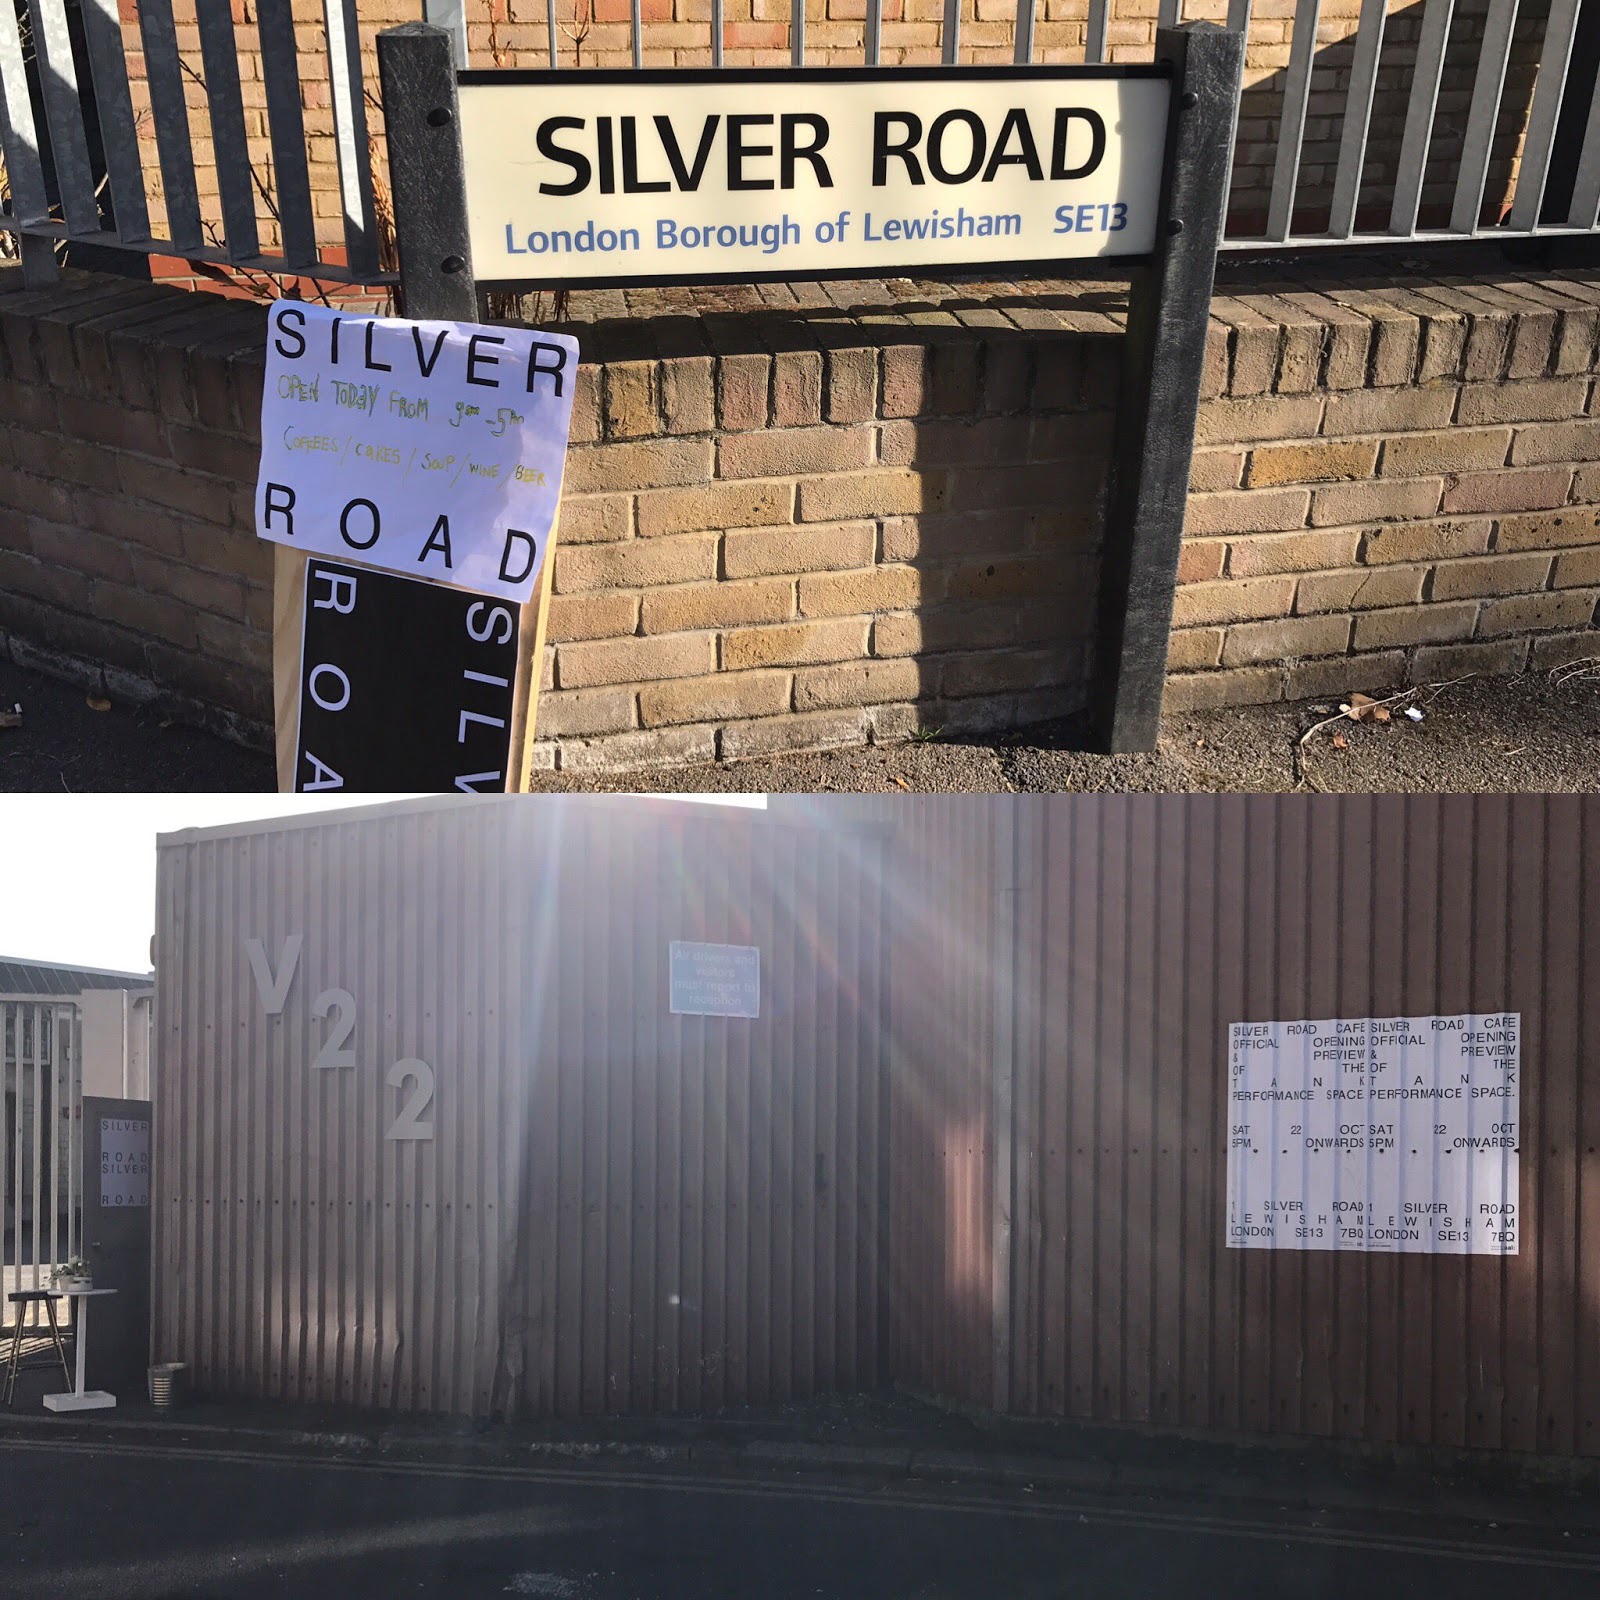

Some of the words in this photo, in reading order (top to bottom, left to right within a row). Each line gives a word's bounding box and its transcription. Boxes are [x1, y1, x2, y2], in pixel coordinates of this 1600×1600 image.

[535, 112, 834, 198] SILVER
[872, 106, 1107, 188] ROAD
[505, 219, 640, 255] London
[656, 214, 801, 255] Borough
[815, 210, 850, 245] of
[864, 208, 1022, 243] Lewisham
[1053, 203, 1128, 234] SE13
[275, 309, 568, 398] SILVER
[278, 373, 320, 402] OPEN
[390, 389, 428, 421] FROM
[265, 482, 537, 584] ROAD
[1233, 1026, 1269, 1036] SILVER
[1287, 1025, 1317, 1035] ROAD
[1336, 1022, 1365, 1033] CAFE
[1371, 1022, 1410, 1032] SILVER
[1431, 1020, 1464, 1031] ROAD
[1484, 1017, 1516, 1029] CAFE
[1233, 1039, 1279, 1049] OFFICIAL
[1313, 1036, 1365, 1047] OPENING
[1371, 1035, 1426, 1046] OFFICIAL
[1461, 1031, 1516, 1043] OPENING
[1313, 1049, 1365, 1060] PREVIEW
[1371, 1050, 1377, 1059] &
[1461, 1045, 1516, 1057] PREVIEW
[1233, 1065, 1245, 1075] OF
[1342, 1063, 1365, 1073] THE
[1371, 1063, 1387, 1073] OF
[1493, 1059, 1516, 1070] THE
[1233, 1091, 1314, 1101] PERFORMANCE
[1370, 1088, 1462, 1100] PERFORMANCE
[1471, 1087, 1515, 1098] SPACE.
[102, 1120, 148, 1131] SILVER
[1232, 1125, 1250, 1135] SAT
[1290, 1125, 1302, 1135] 22
[1369, 1124, 1393, 1135] SAT
[1434, 1124, 1447, 1135] 22
[1491, 1123, 1515, 1134] OCT
[1232, 1138, 1251, 1148] 5PM
[1305, 1138, 1364, 1148] ONWARDS
[1369, 1138, 1394, 1148] 5PM
[1453, 1138, 1515, 1148] ONWARDS
[102, 1152, 148, 1162] ROAD
[102, 1163, 148, 1174] SILVER
[102, 1195, 148, 1205] ROAD
[1264, 1201, 1303, 1211] SILVER
[1332, 1201, 1363, 1211] ROAD
[1404, 1203, 1448, 1214] SILVER
[1480, 1203, 1515, 1214] ROAD
[1231, 1226, 1274, 1236] LONDON
[1295, 1228, 1323, 1238] SE13
[1341, 1228, 1363, 1239] 7BQ
[1368, 1229, 1419, 1240] LONDON
[1438, 1230, 1469, 1242] SE13
[1491, 1231, 1515, 1242] 7BQ
